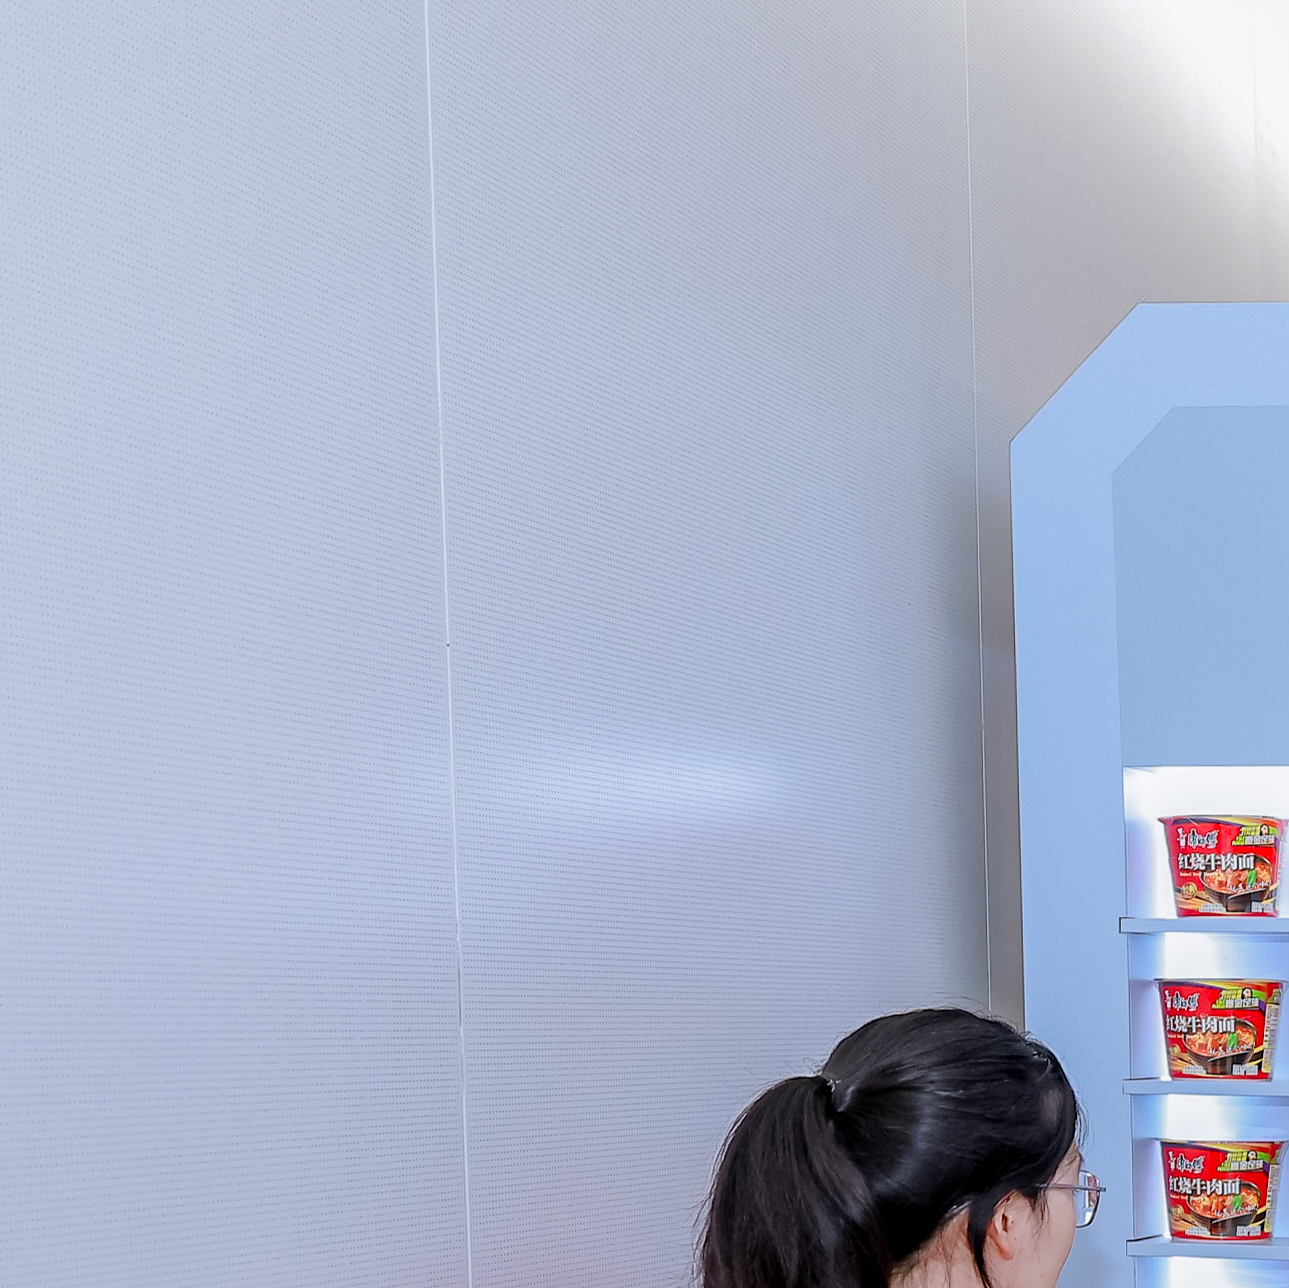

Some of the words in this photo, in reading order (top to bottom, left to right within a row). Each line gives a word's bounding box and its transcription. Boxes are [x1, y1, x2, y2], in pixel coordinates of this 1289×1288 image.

[1177, 853, 1255, 871] 红烧牛肉面
[1166, 1015, 1235, 1034] 红烧牛肉面
[1169, 1177, 1240, 1196] 红烧牛肉面
